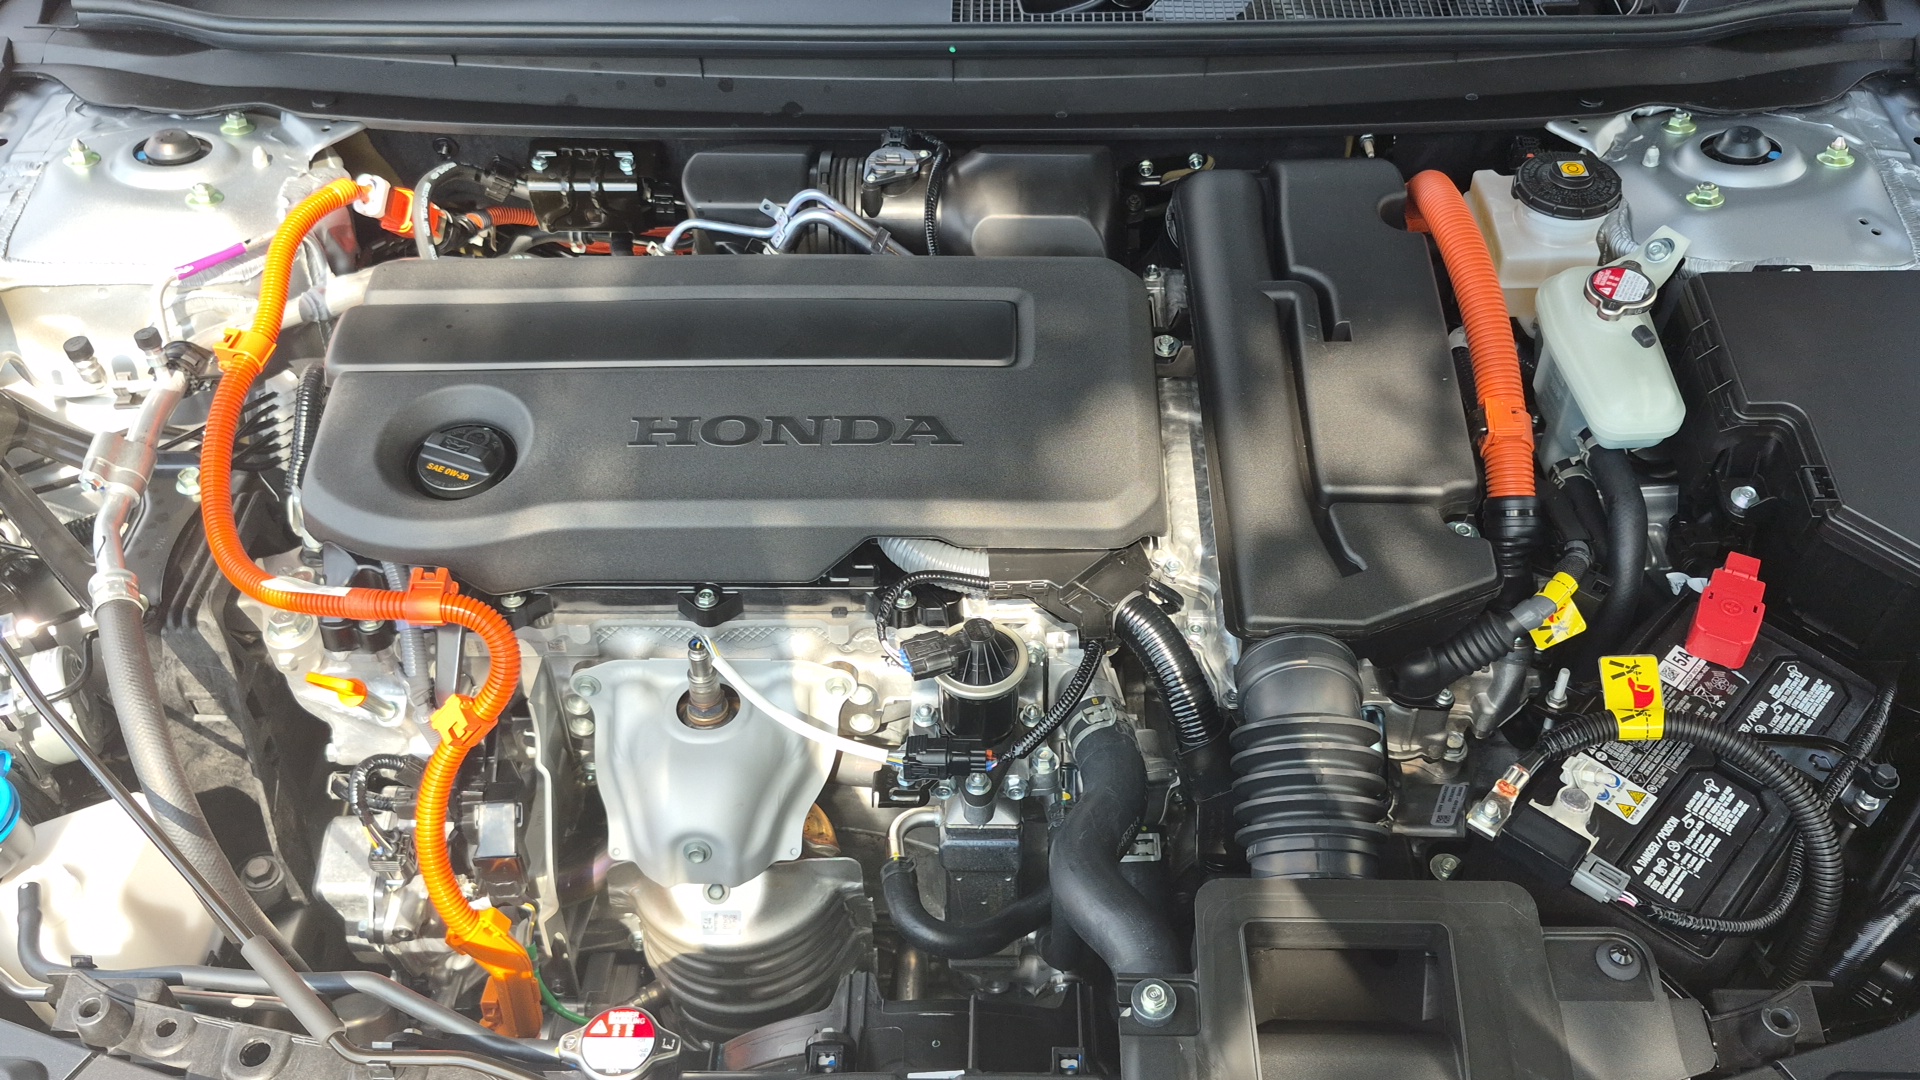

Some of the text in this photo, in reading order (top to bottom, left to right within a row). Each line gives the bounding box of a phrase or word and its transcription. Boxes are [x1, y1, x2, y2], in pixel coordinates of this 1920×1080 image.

[627, 415, 964, 447] HONDA
[426, 462, 470, 481] SAE 0W-20
